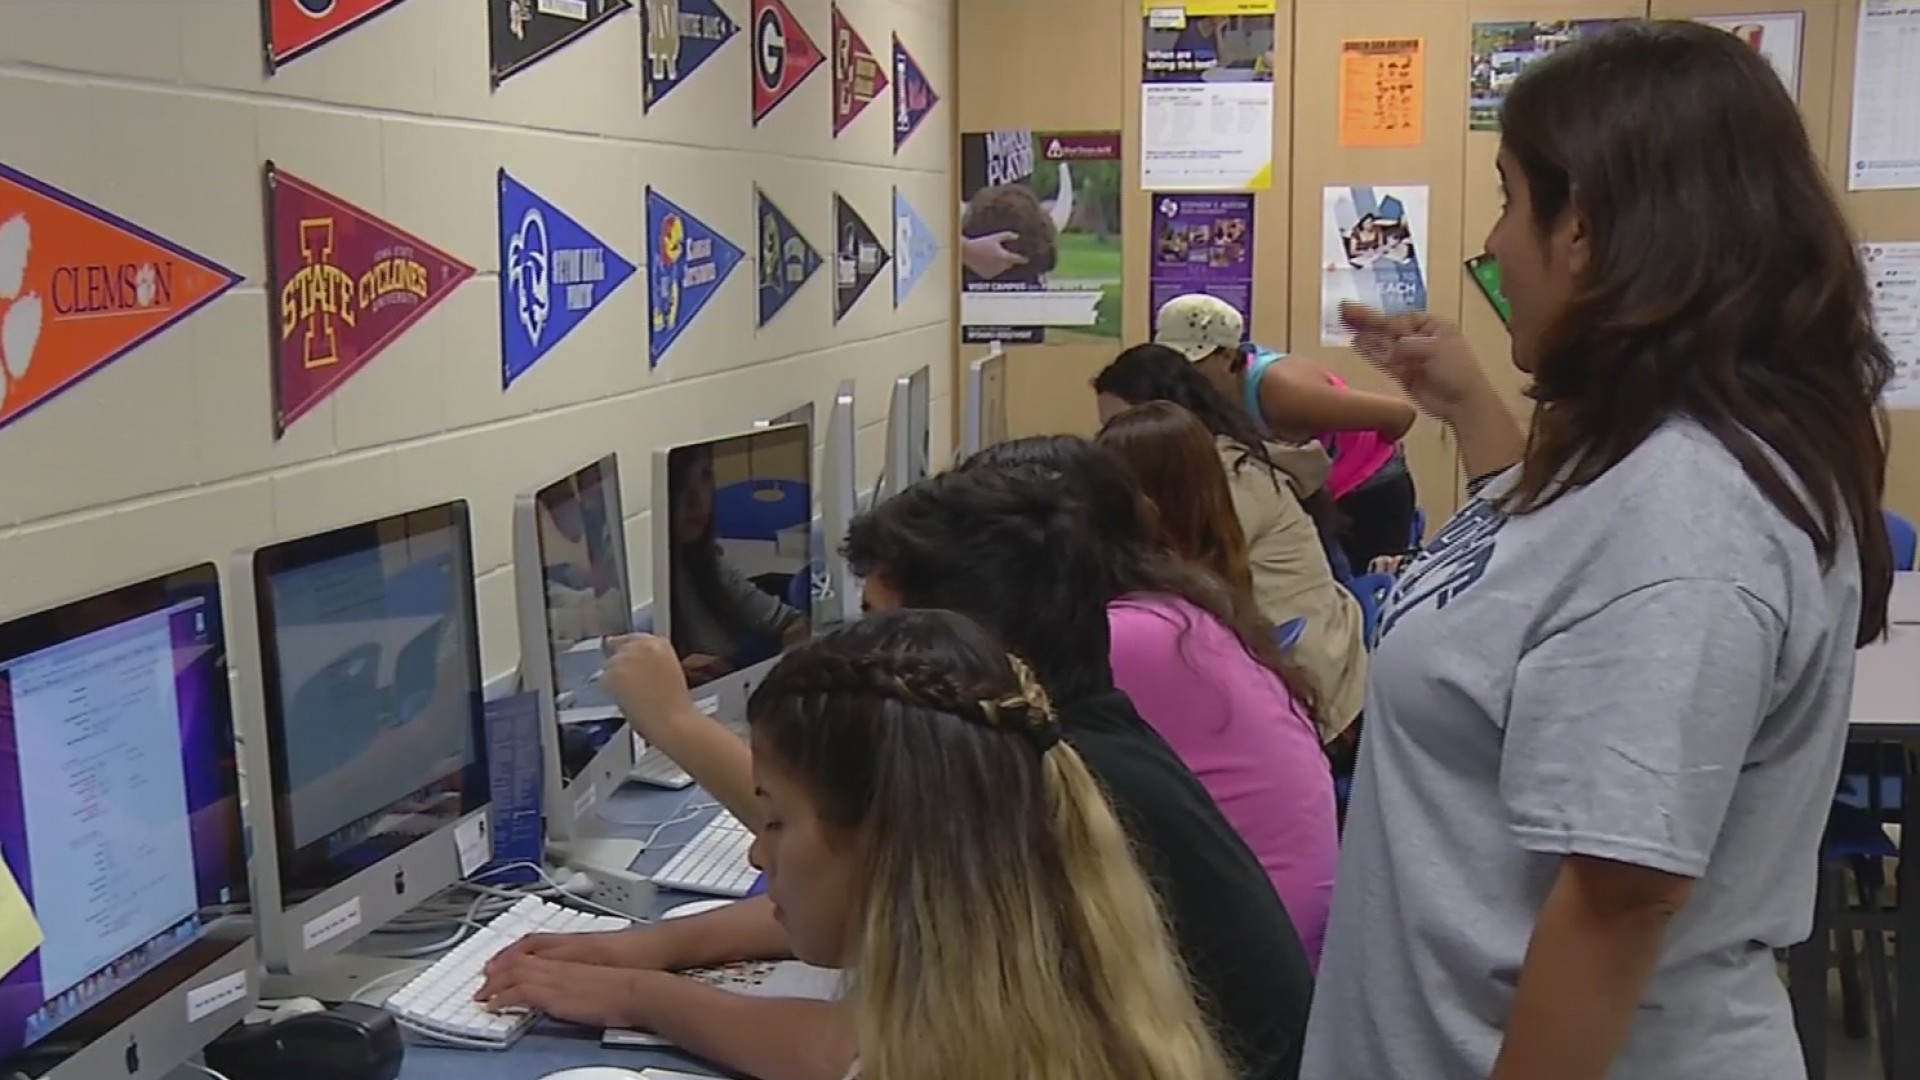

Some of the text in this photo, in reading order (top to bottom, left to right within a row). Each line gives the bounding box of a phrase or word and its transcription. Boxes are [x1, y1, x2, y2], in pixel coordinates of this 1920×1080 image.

[758, 8, 785, 90] G
[281, 264, 356, 341] STATE
[358, 258, 428, 310] CYCLONES
